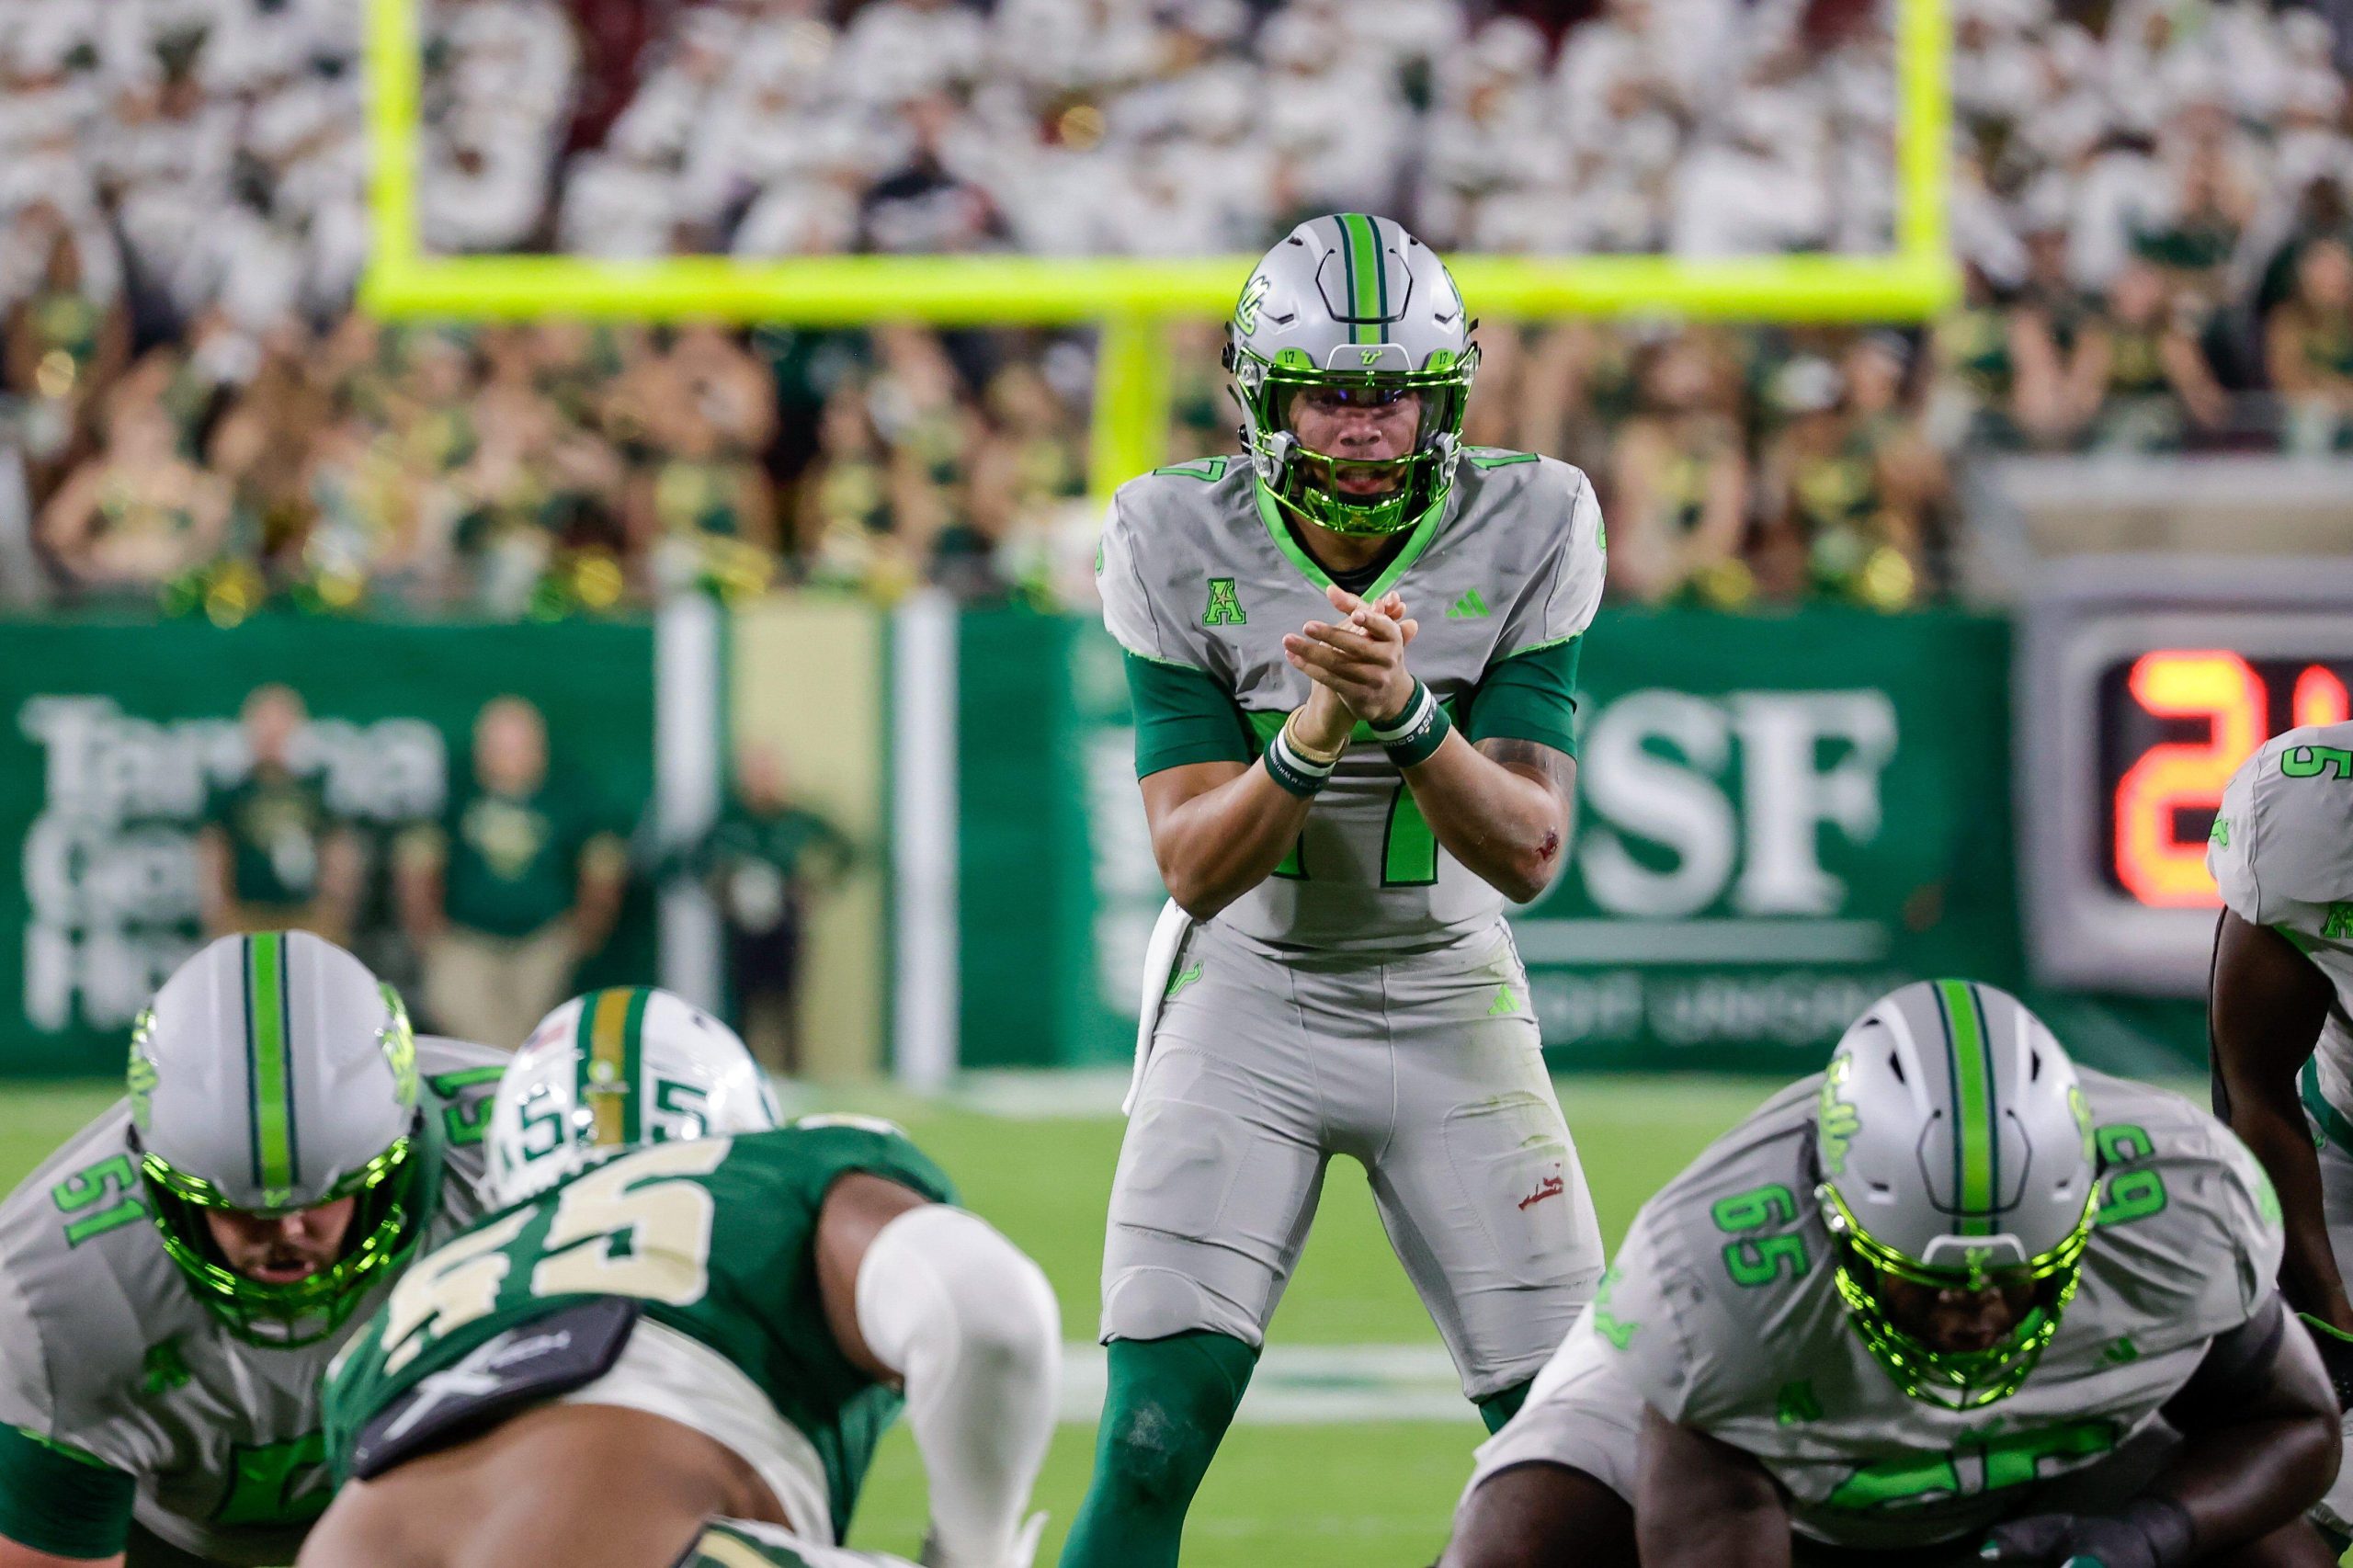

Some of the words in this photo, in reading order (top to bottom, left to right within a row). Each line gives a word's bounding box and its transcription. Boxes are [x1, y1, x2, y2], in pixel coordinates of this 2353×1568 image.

[1284, 350, 1295, 364] 17
[1438, 351, 1449, 365] 17
[1202, 576, 1247, 627] A
[1574, 685, 1899, 917] SF
[51, 1153, 147, 1250] 51
[1711, 1182, 1811, 1287] 65
